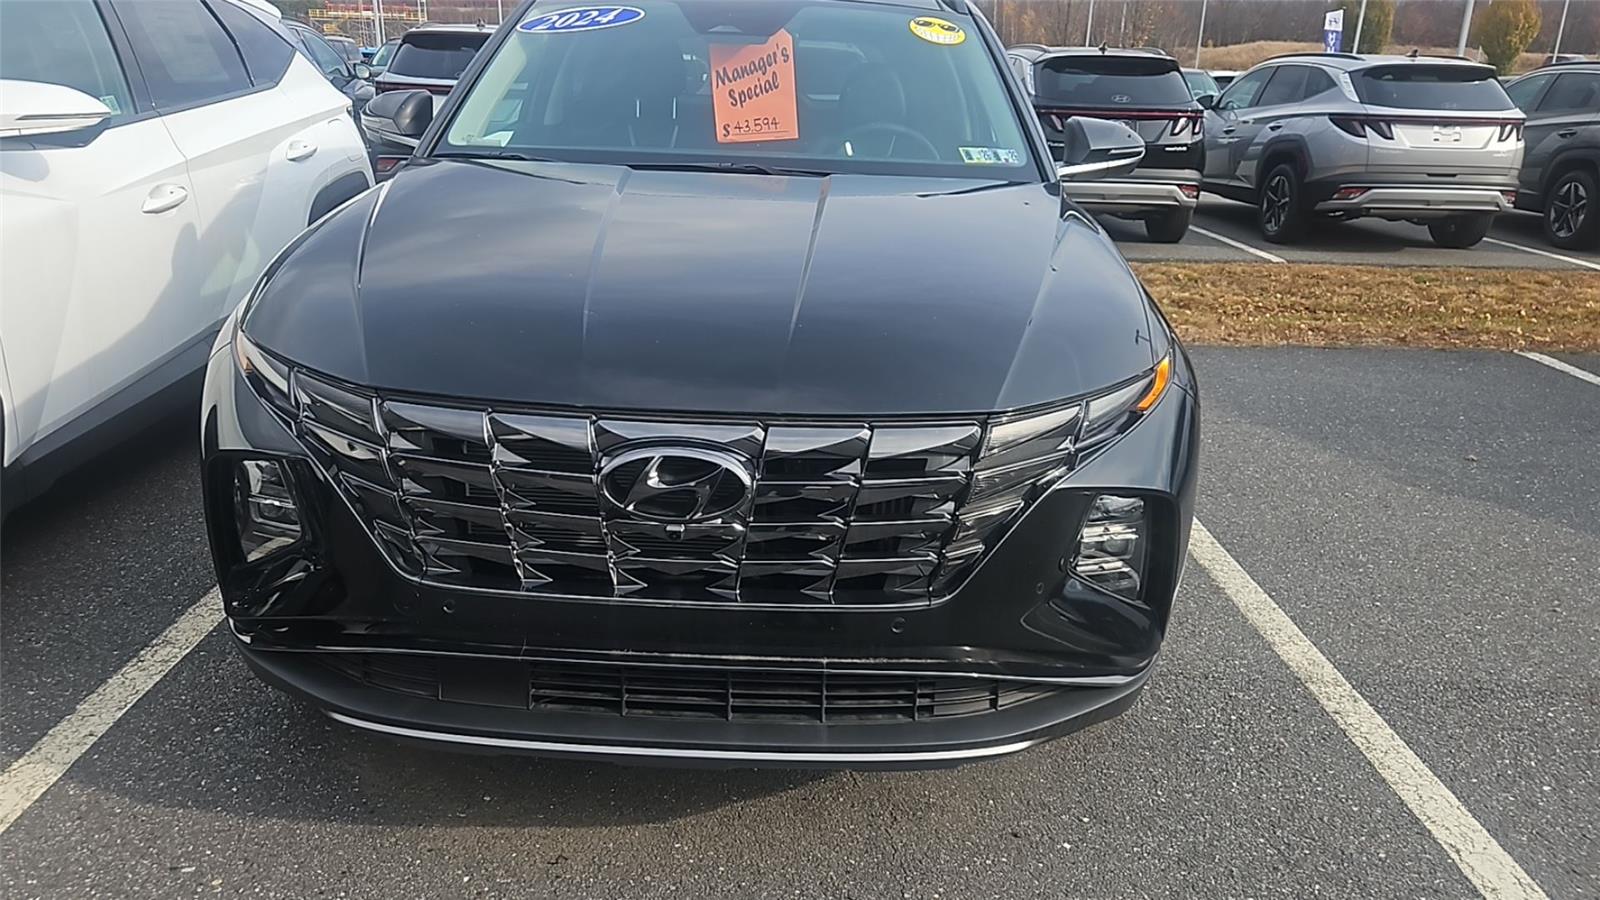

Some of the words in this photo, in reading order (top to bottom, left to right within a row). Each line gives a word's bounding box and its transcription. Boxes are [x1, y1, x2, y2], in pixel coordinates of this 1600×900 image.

[532, 8, 624, 31] 2024
[715, 43, 790, 88] Manager's
[728, 70, 780, 108] Special
